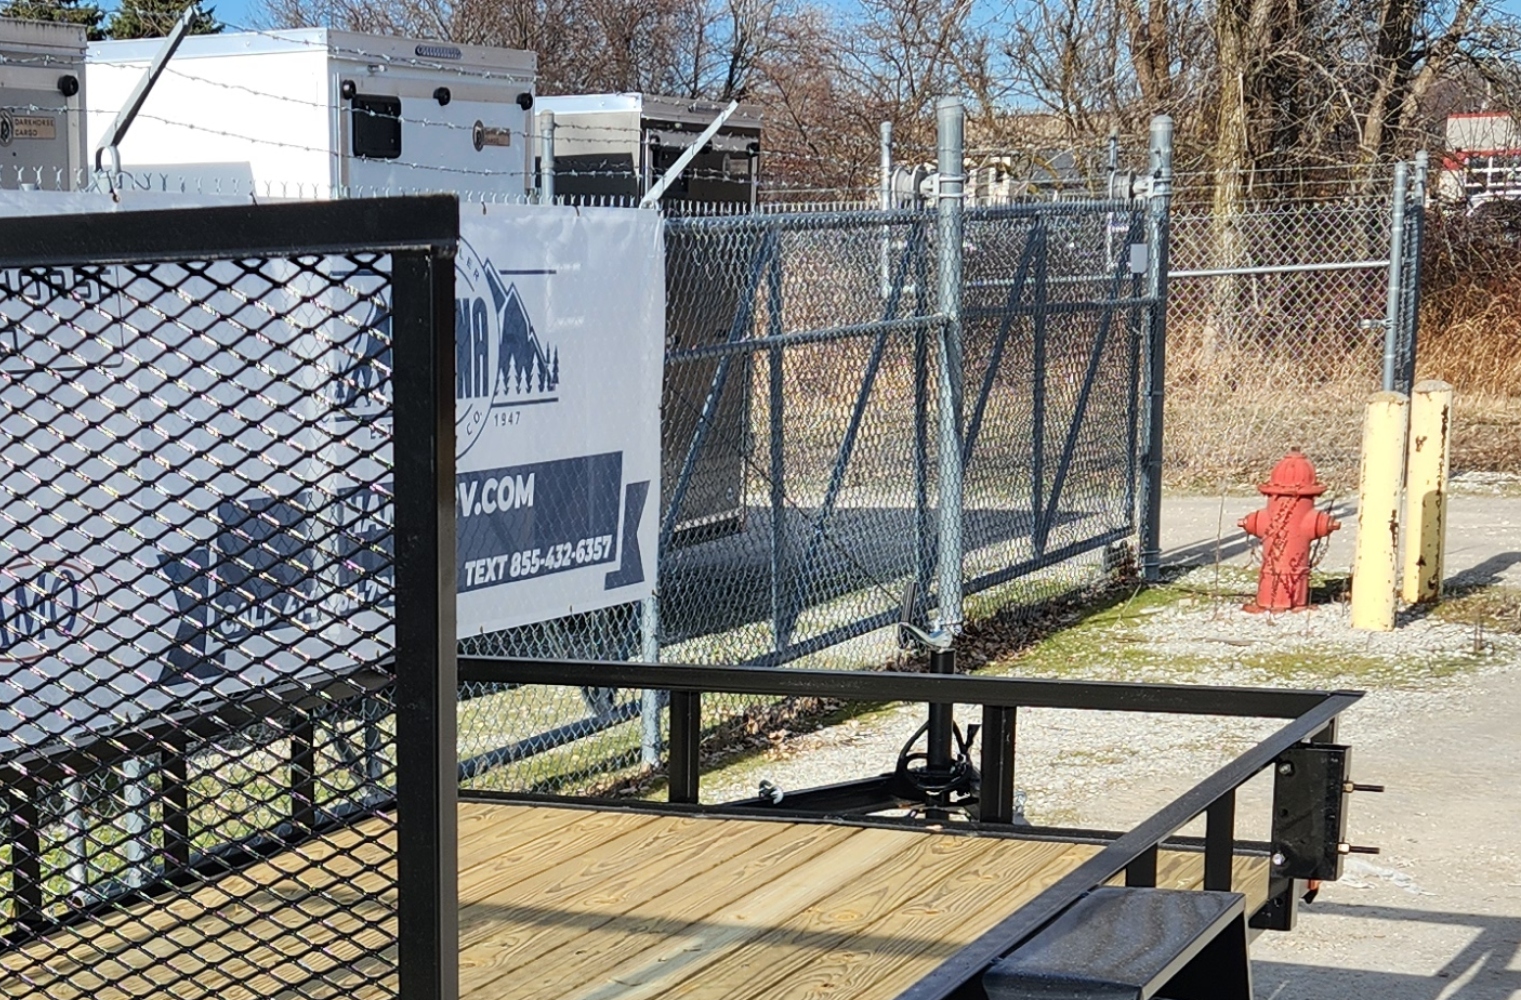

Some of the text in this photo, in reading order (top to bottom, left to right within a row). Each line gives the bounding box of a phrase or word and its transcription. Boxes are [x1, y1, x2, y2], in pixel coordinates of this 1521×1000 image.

[14, 118, 55, 127] DARKHORSE
[14, 128, 39, 137] CARGO
[494, 411, 521, 427] 1947
[456, 473, 535, 518] V.COM
[465, 534, 613, 586] TEXT 855-432-6357
